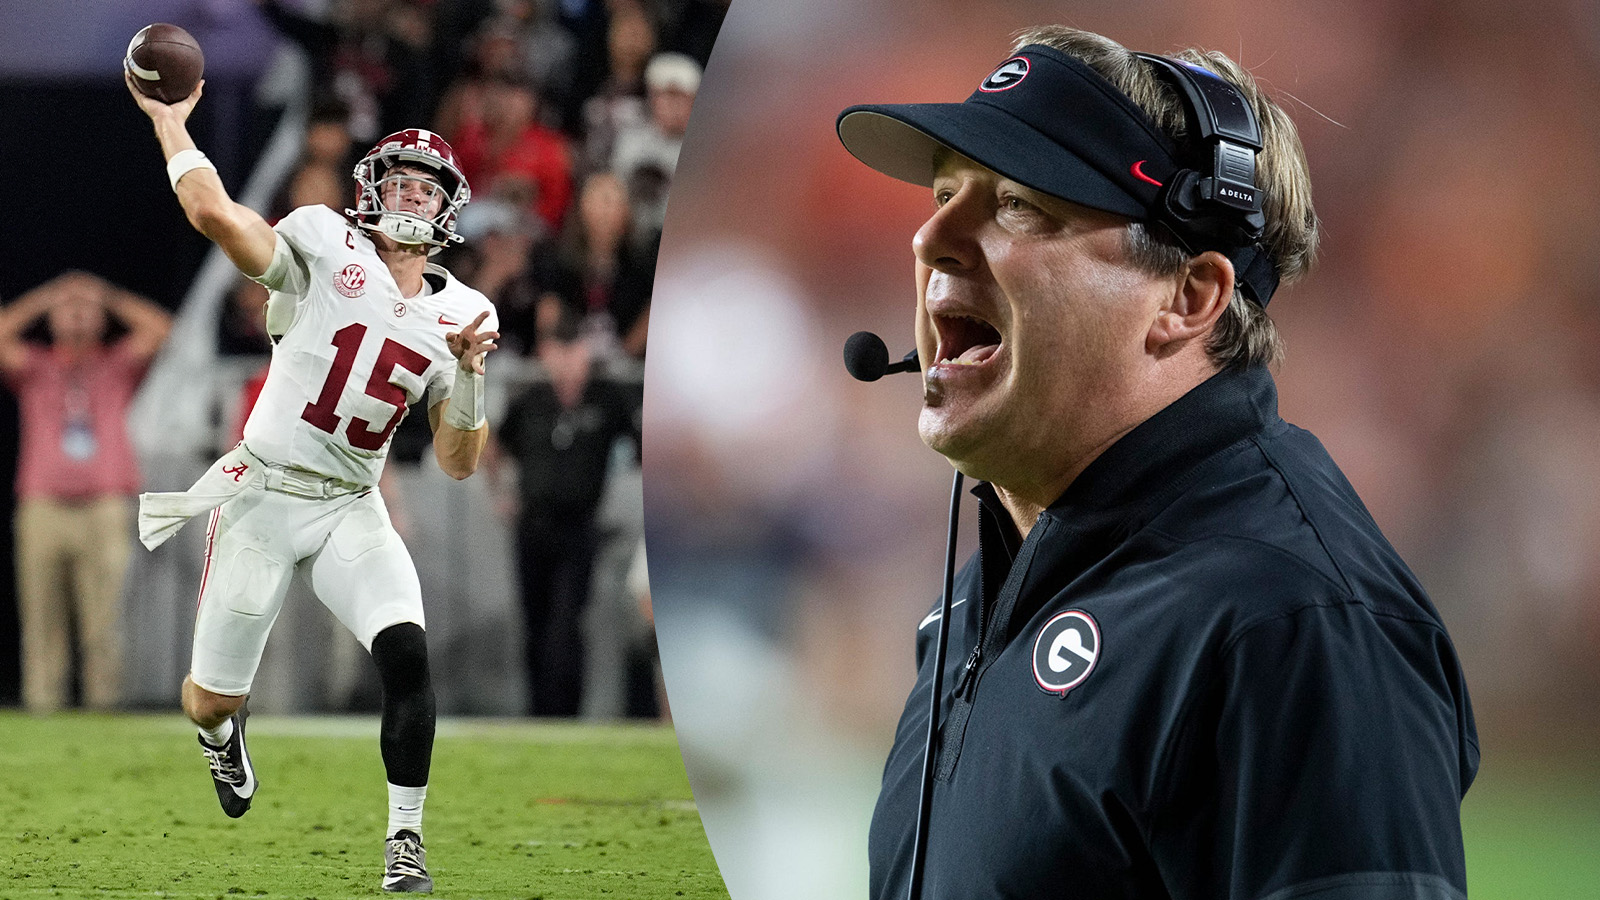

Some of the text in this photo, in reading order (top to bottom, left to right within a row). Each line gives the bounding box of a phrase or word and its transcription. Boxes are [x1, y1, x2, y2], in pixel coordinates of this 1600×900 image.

[983, 58, 1029, 90] G
[1228, 189, 1253, 202] DELTA
[341, 264, 365, 289] SEC
[300, 322, 433, 451] 15
[222, 461, 248, 482] A
[1035, 614, 1097, 687] G
